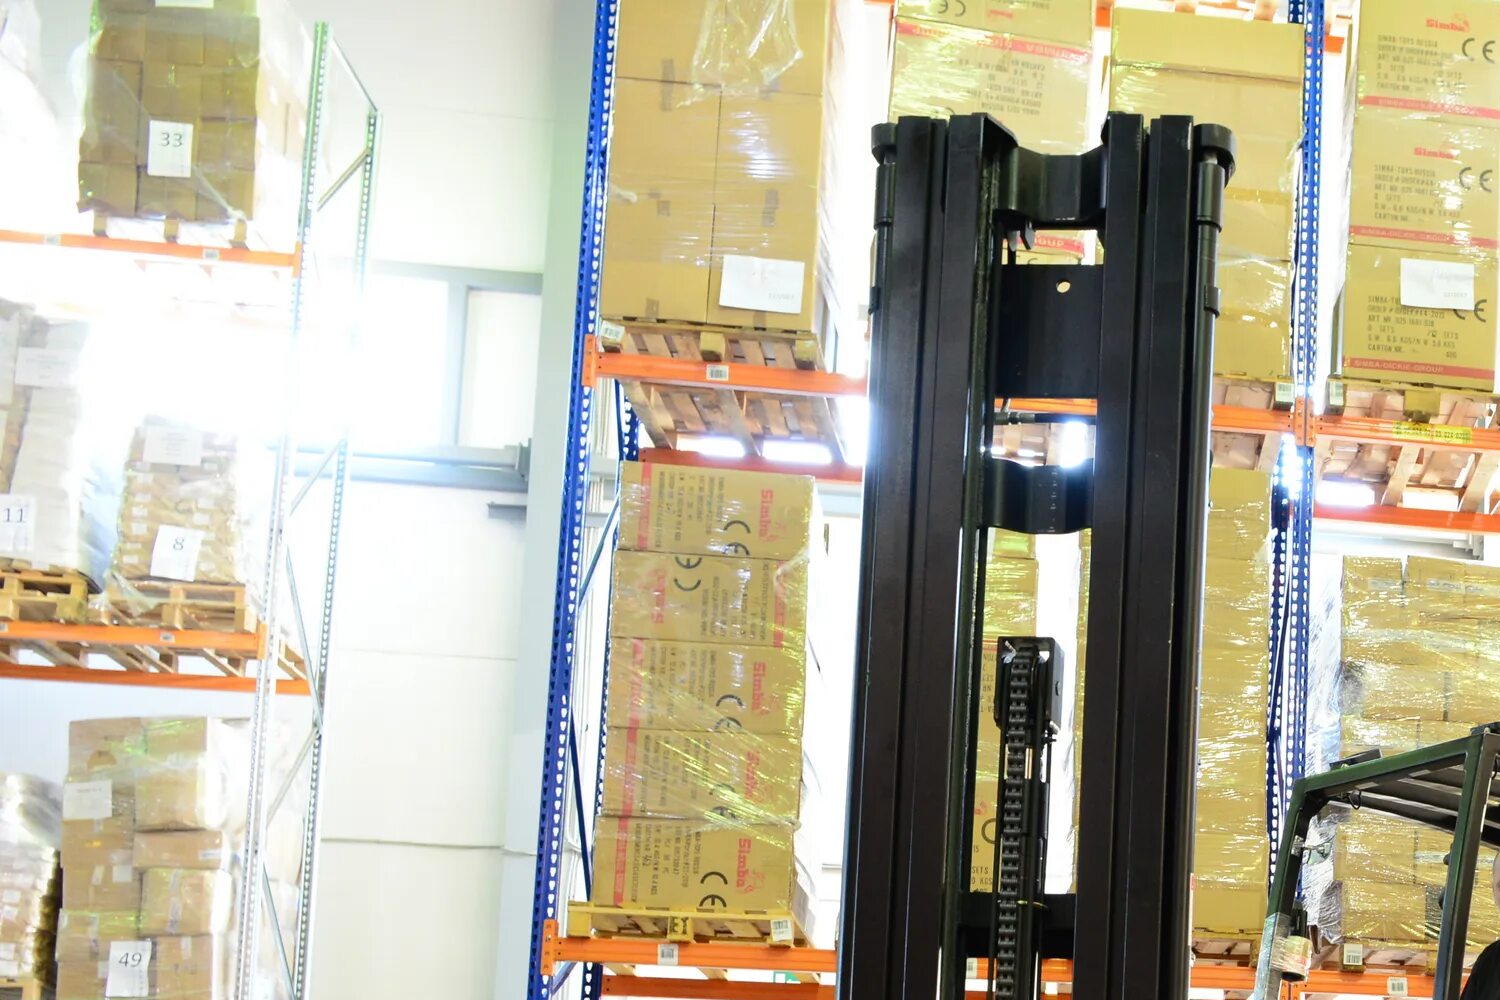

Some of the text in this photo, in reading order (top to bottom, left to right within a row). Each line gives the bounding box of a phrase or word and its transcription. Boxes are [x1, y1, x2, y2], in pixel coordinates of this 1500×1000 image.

[160, 132, 184, 148] 33
[759, 488, 774, 538] Simba
[751, 661, 767, 711] Simba
[736, 838, 752, 888] Simba
[699, 870, 729, 908] CE
[117, 951, 143, 968] 49
